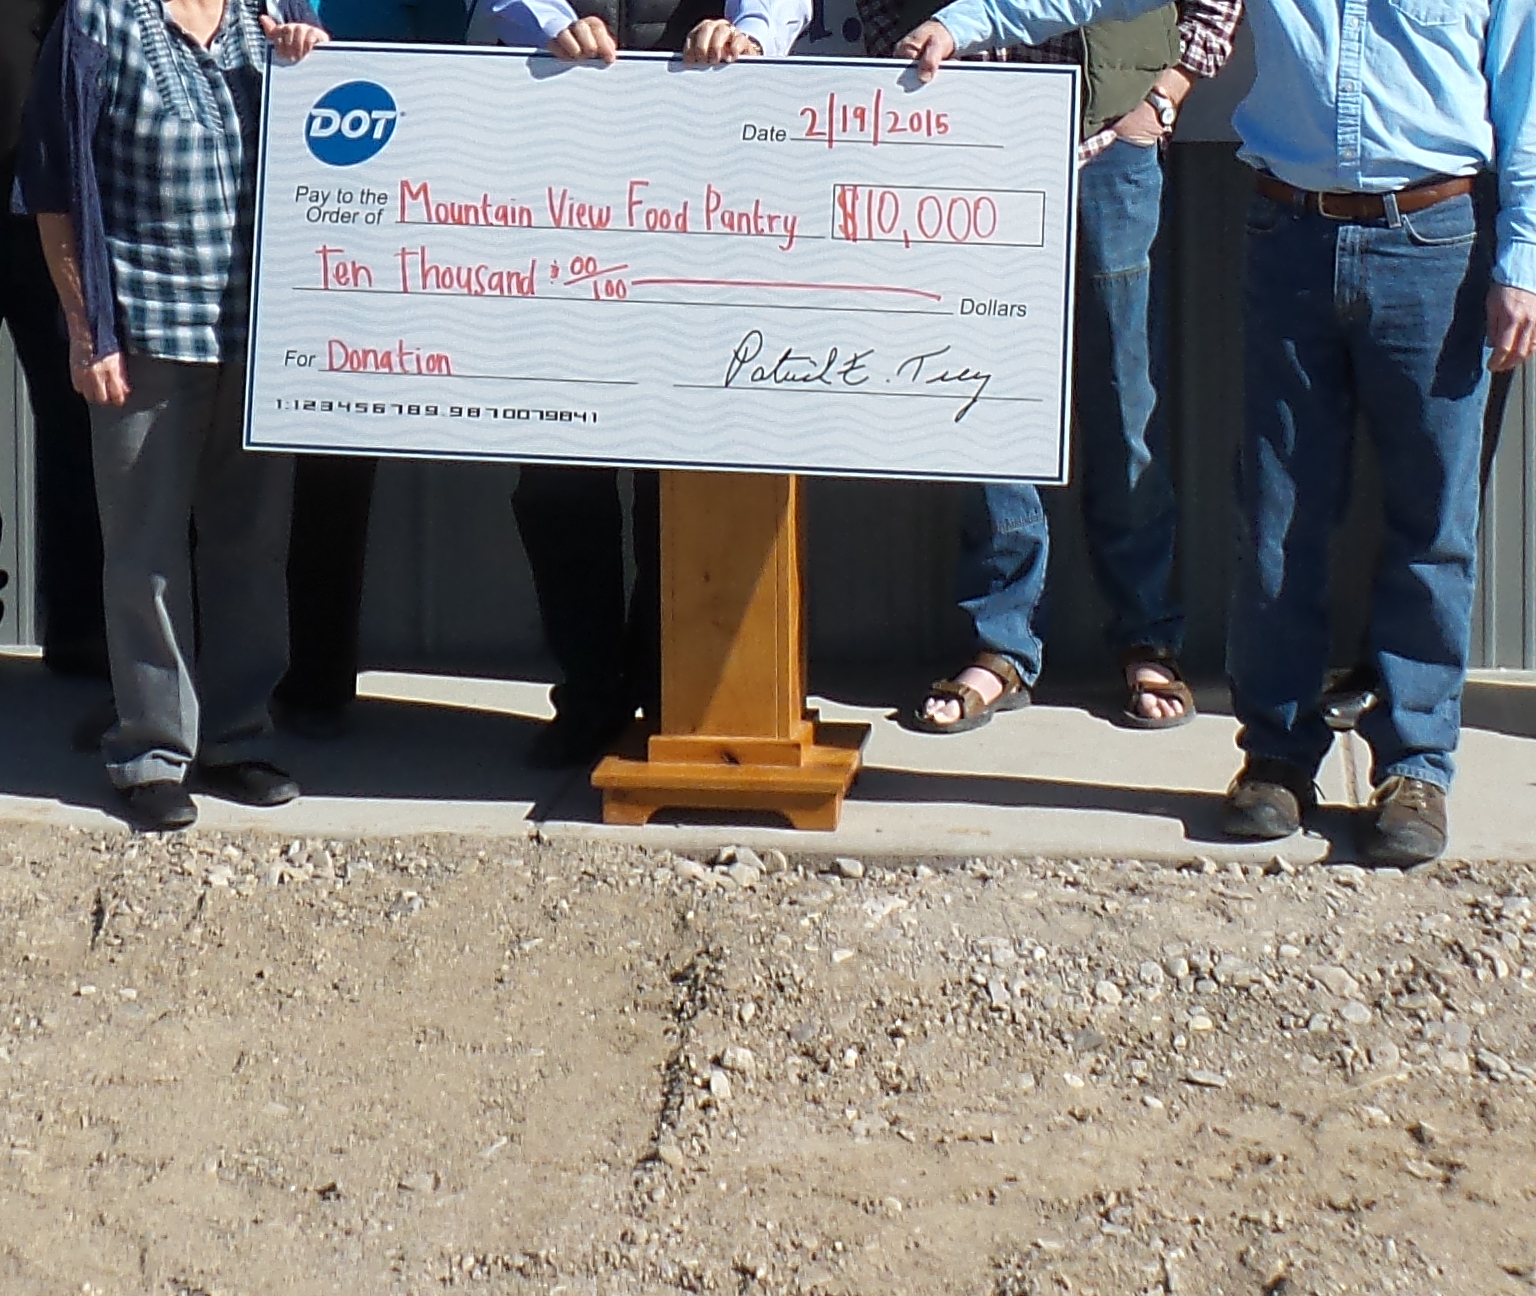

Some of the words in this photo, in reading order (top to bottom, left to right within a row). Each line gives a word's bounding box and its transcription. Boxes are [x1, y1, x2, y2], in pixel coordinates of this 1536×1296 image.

[309, 108, 397, 140] DOT
[742, 123, 787, 142] Date
[295, 185, 331, 205] Pay
[336, 187, 354, 204] to
[360, 188, 388, 206] the
[306, 206, 359, 225] Order
[364, 208, 384, 225] of
[400, 179, 533, 227] Mountain
[547, 185, 612, 230] View
[627, 180, 688, 233] Food
[704, 183, 798, 252] Pantry
[314, 244, 374, 290] Ten
[394, 245, 536, 296] Thousand
[960, 298, 1027, 318] Dollars
[284, 349, 316, 369] For
[328, 339, 453, 376] Donation
